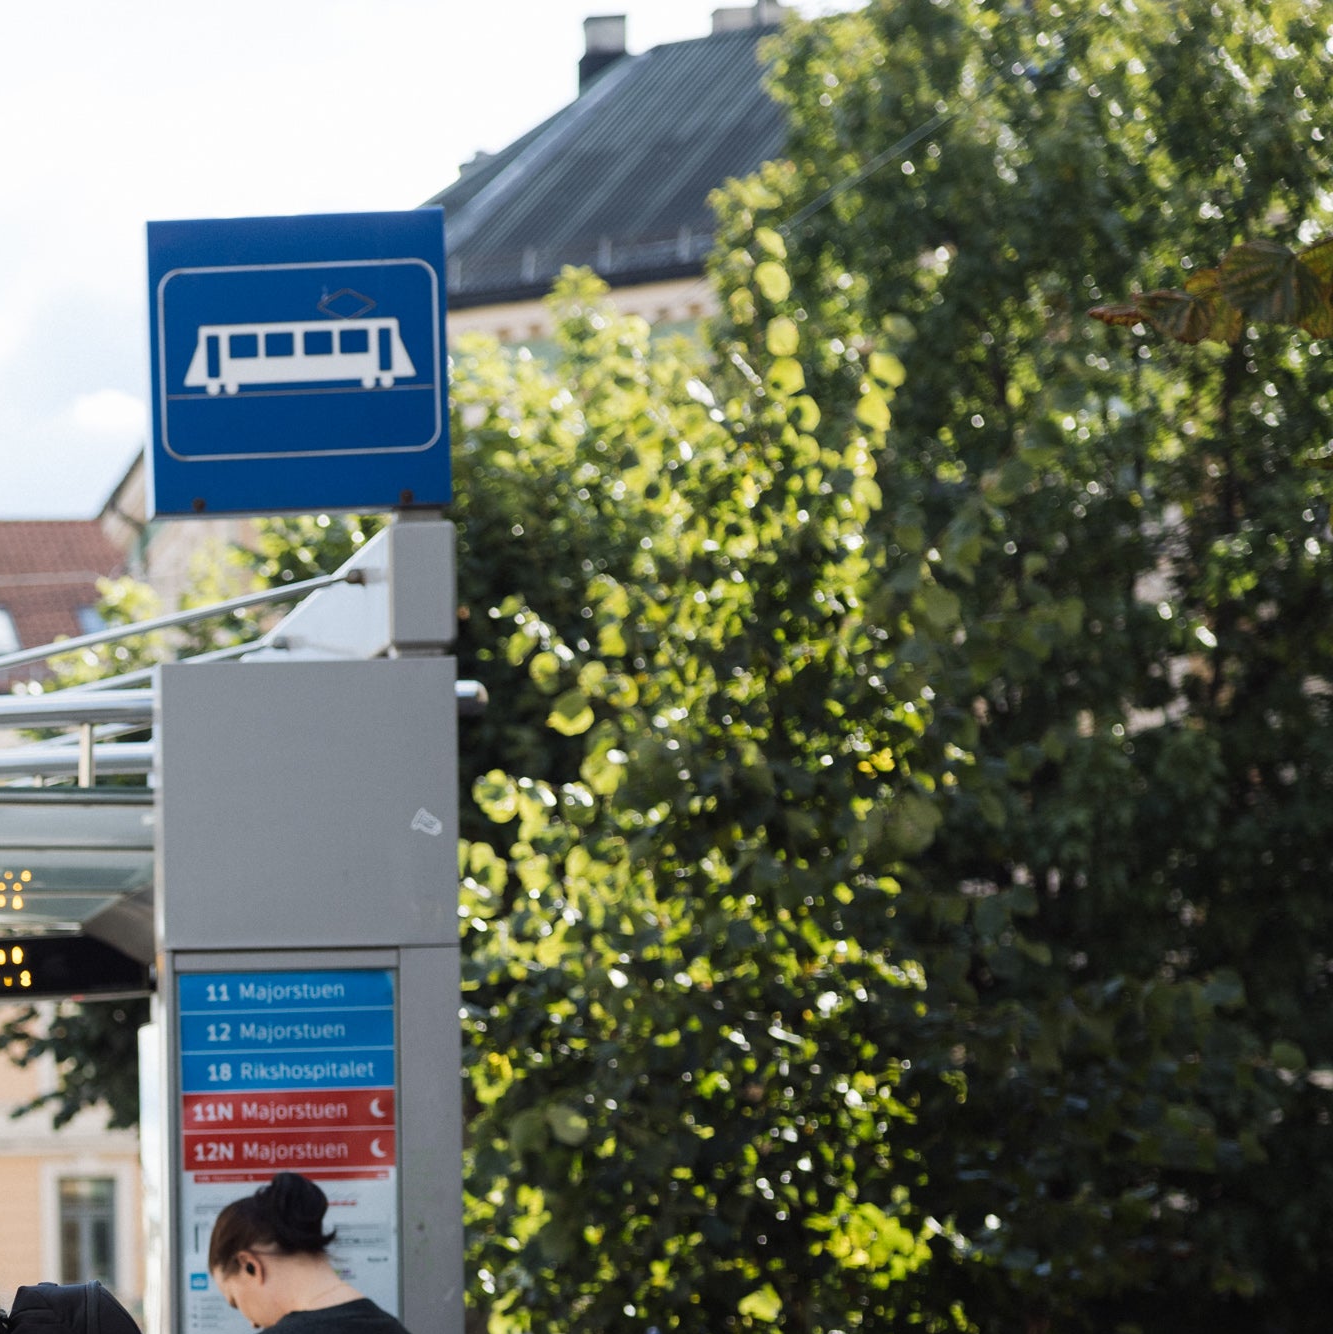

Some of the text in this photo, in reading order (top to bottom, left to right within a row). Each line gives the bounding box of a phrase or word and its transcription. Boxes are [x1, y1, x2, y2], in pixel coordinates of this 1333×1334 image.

[206, 982, 345, 1003] 11 Majorstuen
[206, 1022, 346, 1043] 12 Majorstuen
[207, 1060, 375, 1082] 18 Rikshospitalet
[192, 1100, 348, 1124] 11N Majorstuen
[194, 1140, 349, 1164] 12N Majorstuen
